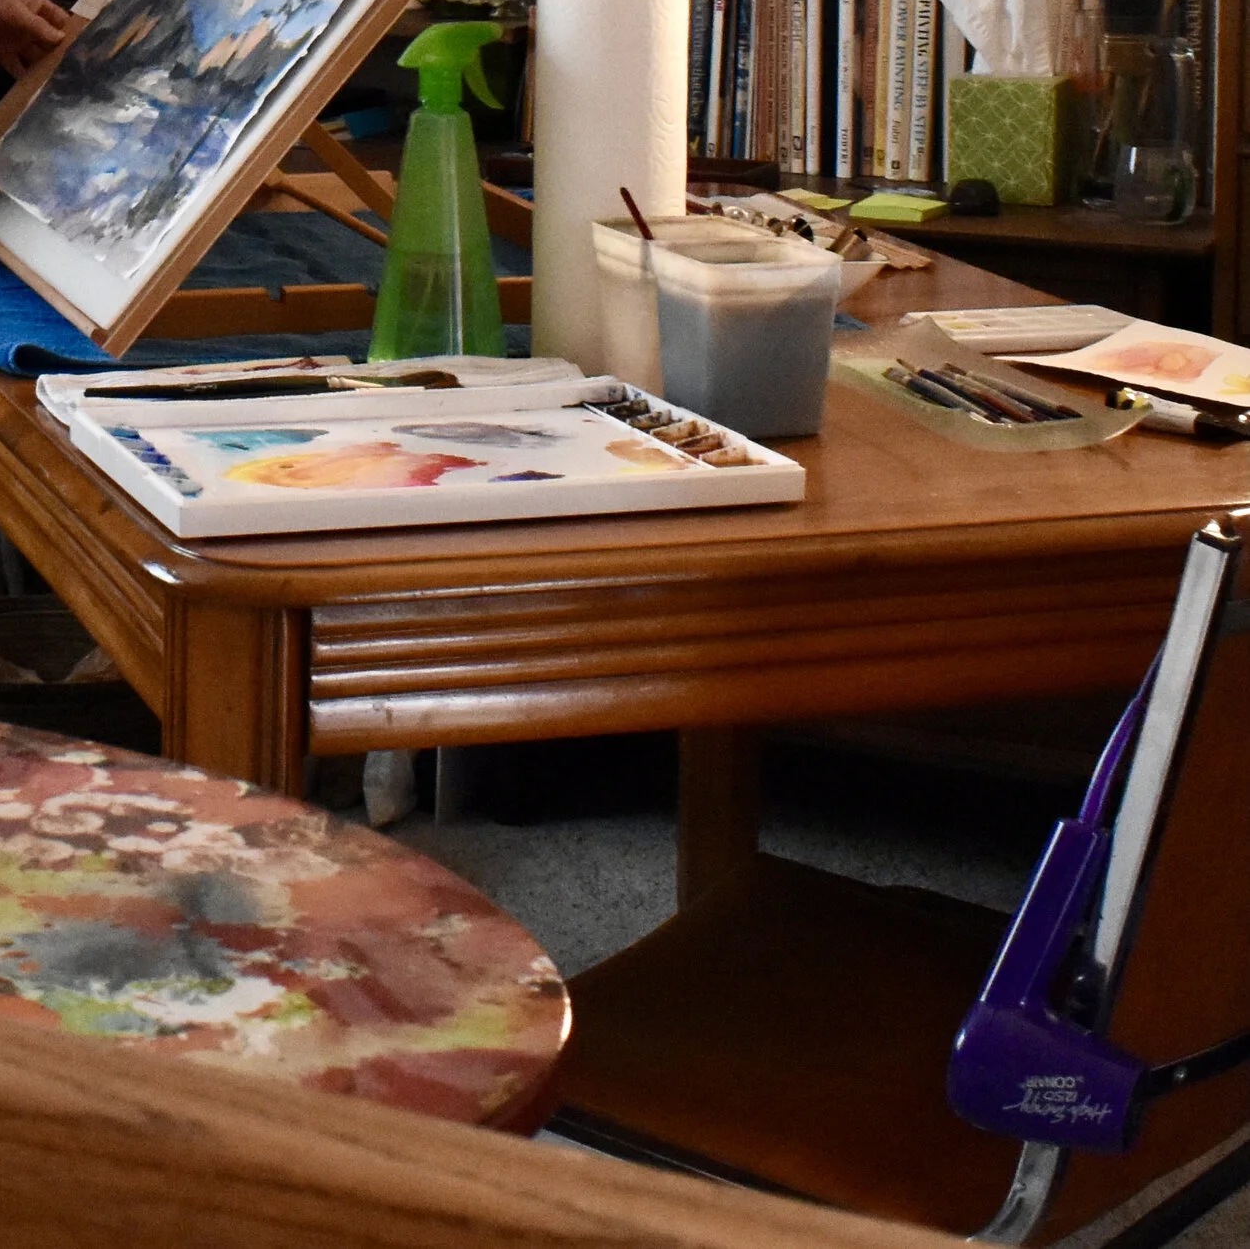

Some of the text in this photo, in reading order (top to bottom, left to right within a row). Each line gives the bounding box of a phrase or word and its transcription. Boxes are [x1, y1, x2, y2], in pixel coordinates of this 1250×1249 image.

[918, 0, 931, 56] PAINTING
[894, 45, 907, 111] PAINTING
[1026, 1076, 1075, 1088] CONAIR
